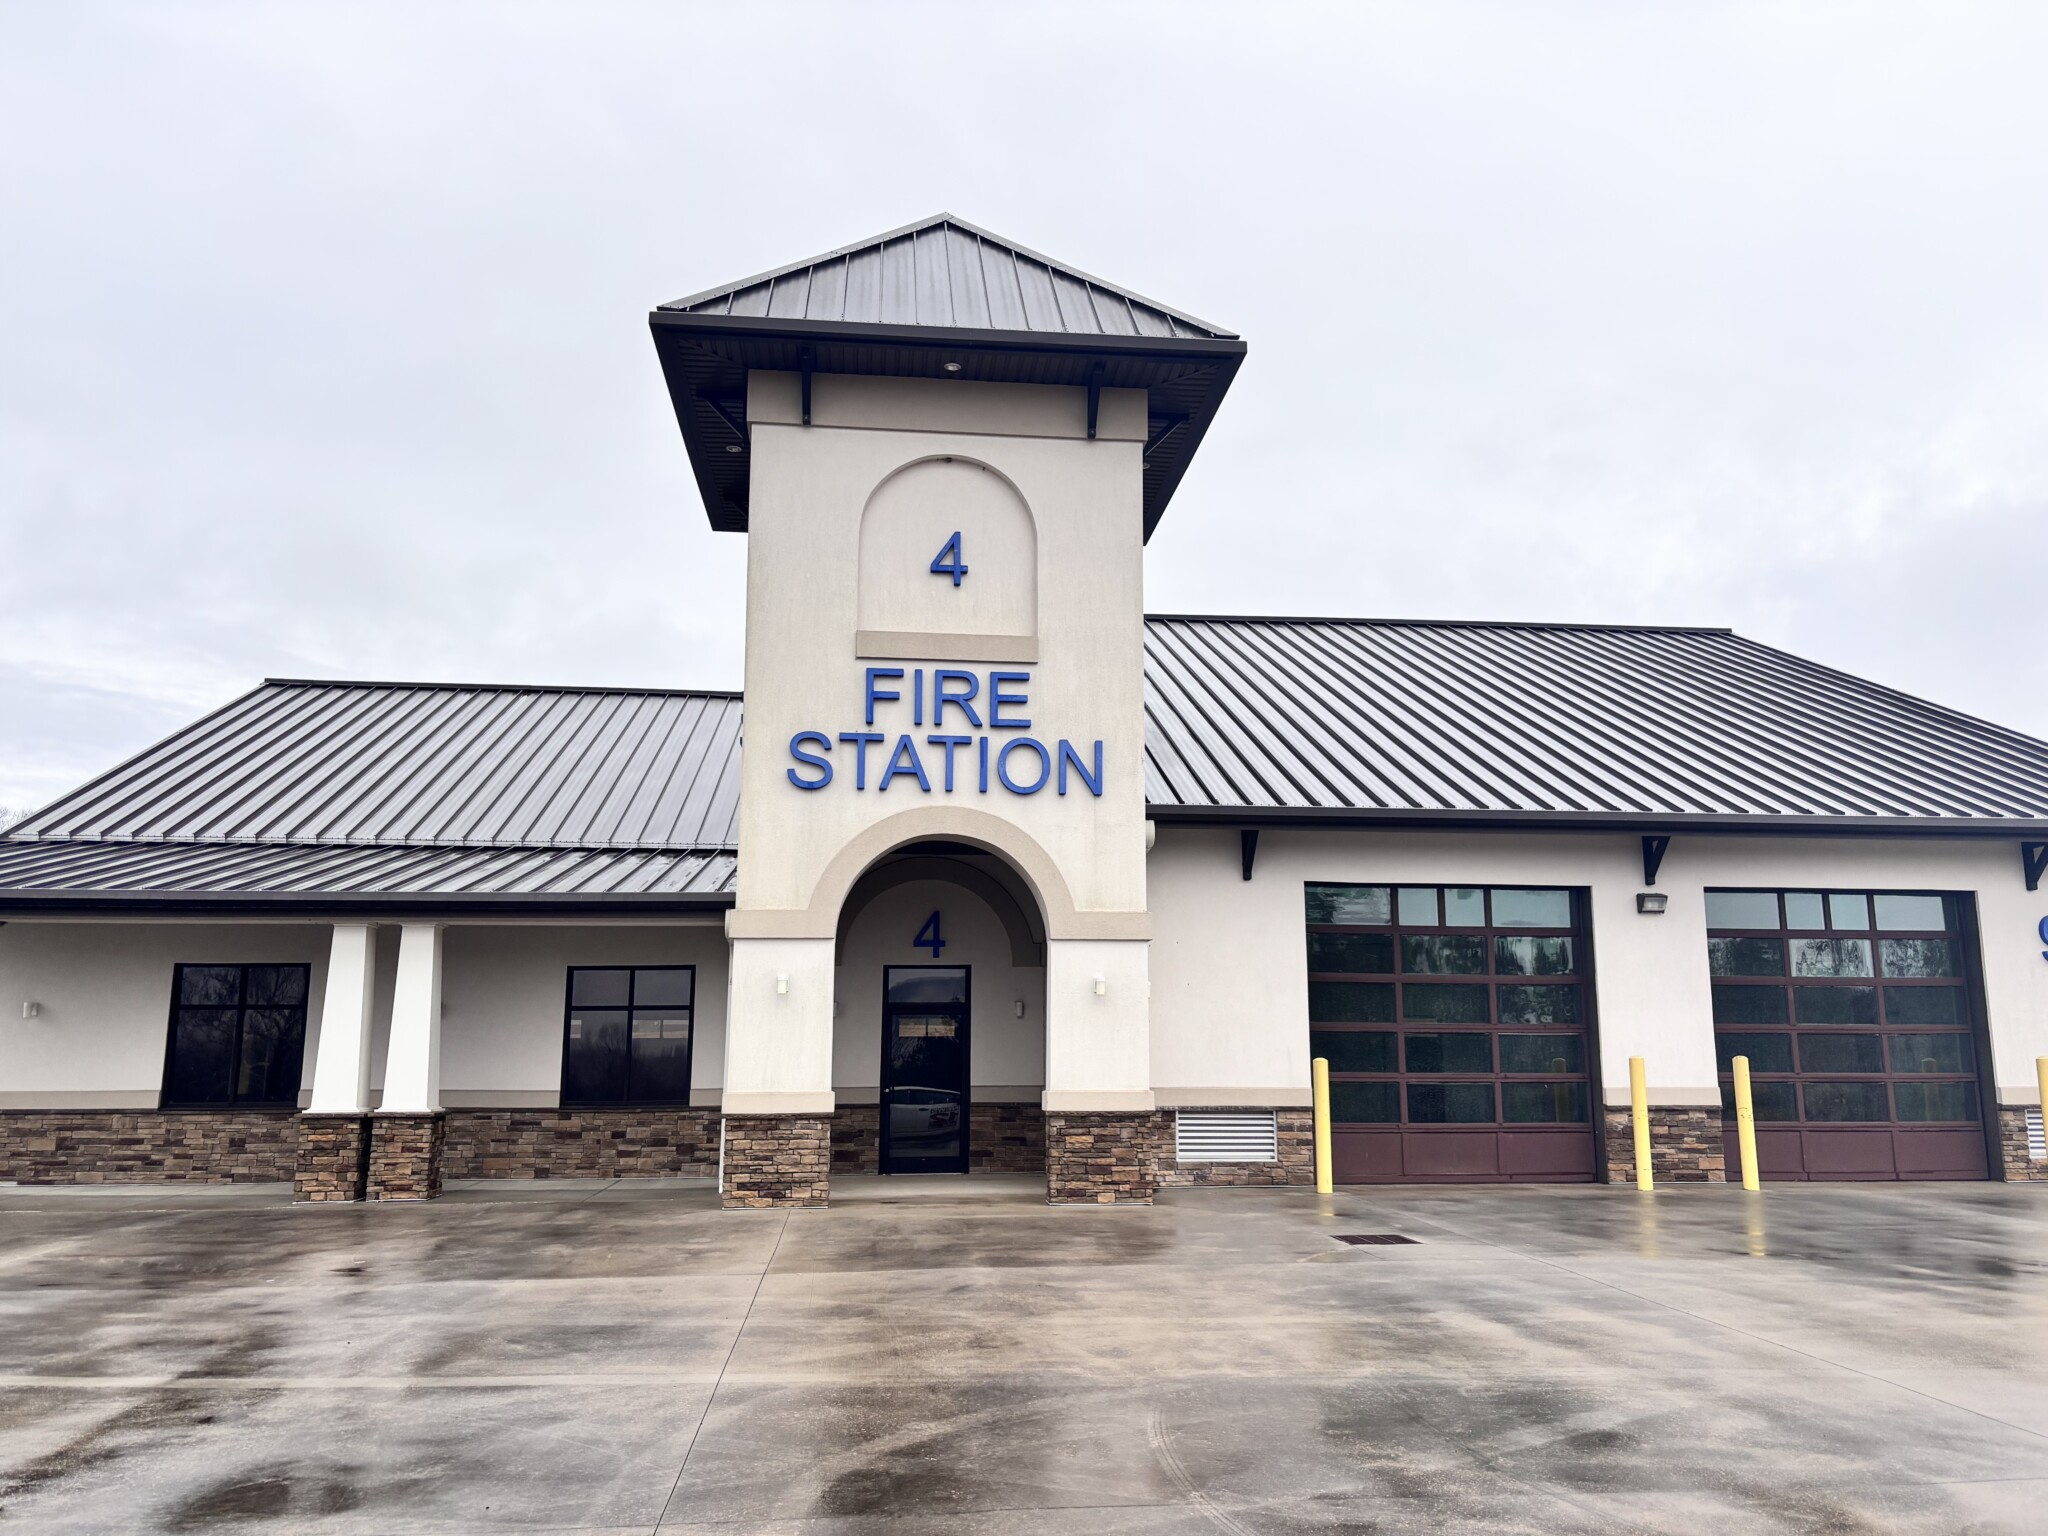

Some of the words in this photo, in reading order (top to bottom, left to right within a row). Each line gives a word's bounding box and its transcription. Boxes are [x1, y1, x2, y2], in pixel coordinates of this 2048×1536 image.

[930, 531, 968, 586] 4
[865, 667, 1032, 728] FIRE
[786, 731, 1103, 796] STATION
[913, 909, 946, 958] 4
